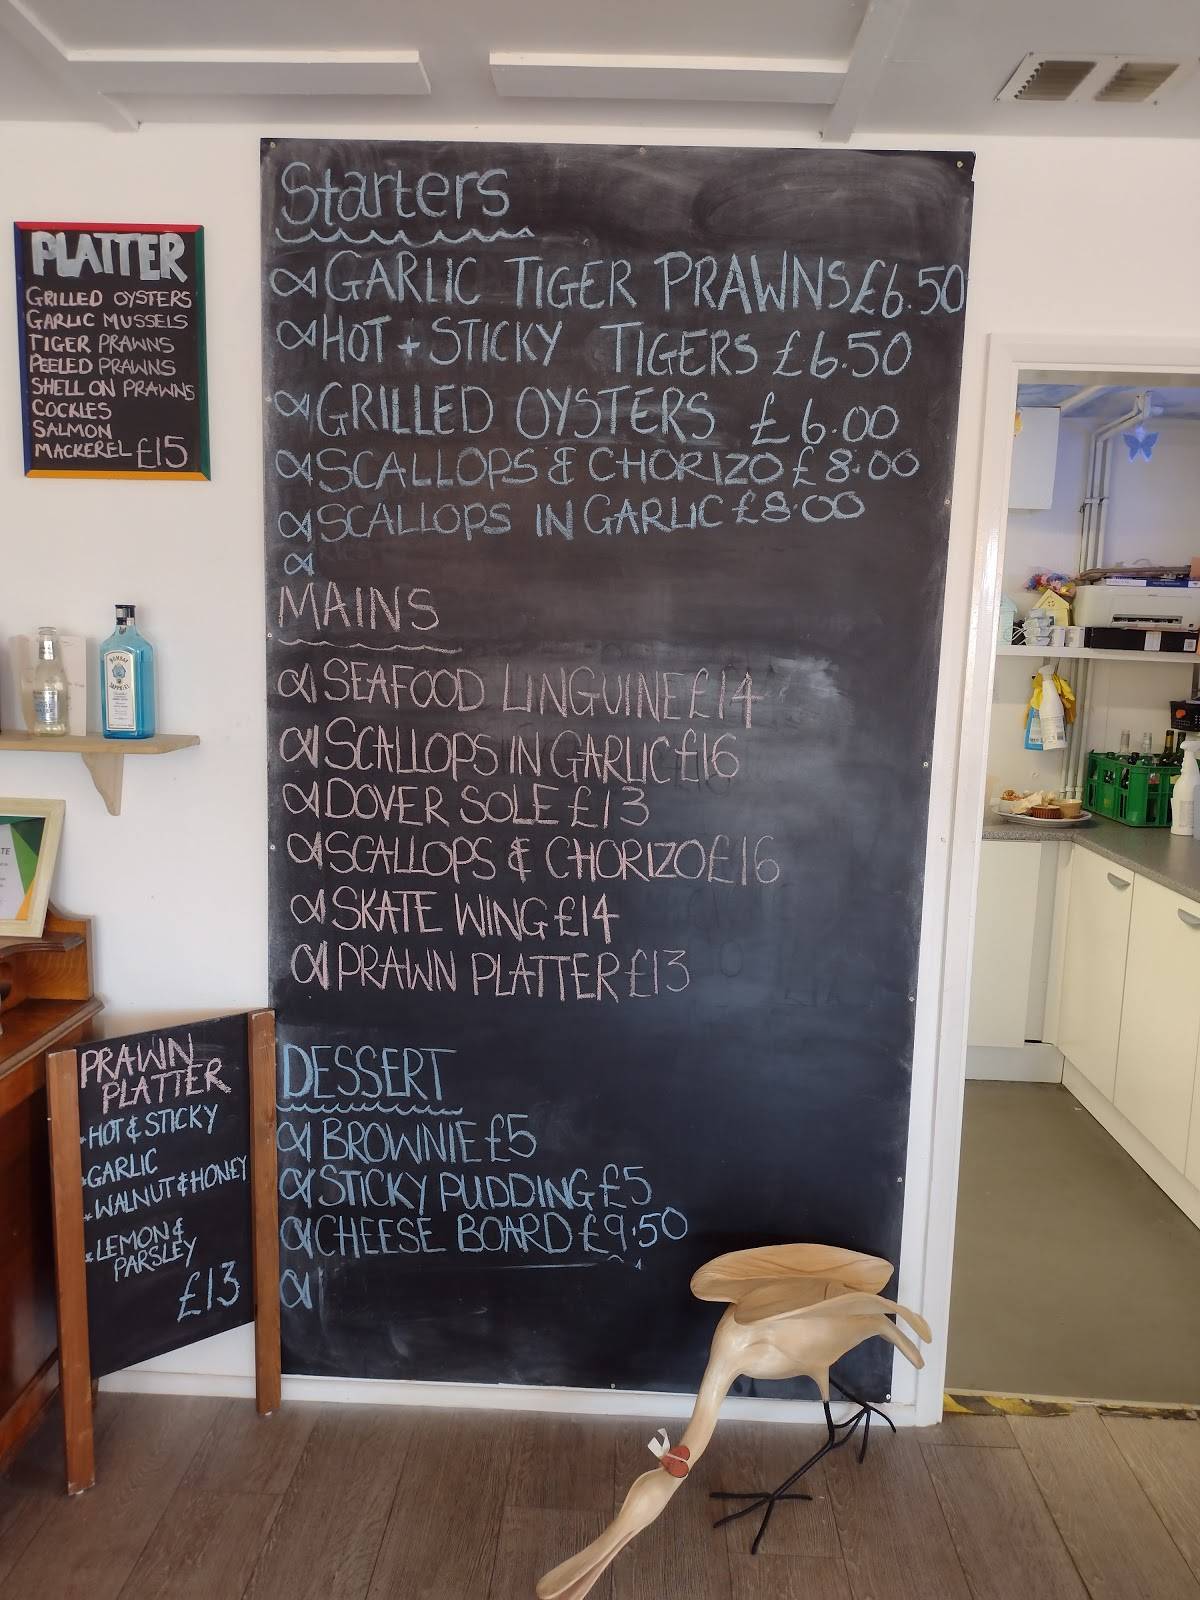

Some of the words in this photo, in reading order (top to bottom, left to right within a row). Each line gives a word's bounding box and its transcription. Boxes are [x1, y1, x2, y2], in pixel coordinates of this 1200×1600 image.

[282, 161, 510, 224] Starters
[31, 231, 188, 283] PLATTER
[325, 250, 482, 304] GARLIC
[504, 256, 637, 309] TIGER
[654, 251, 851, 313] PRAWNS
[25, 286, 103, 307] GRILLED
[113, 289, 192, 309] OYSTERS
[26, 309, 95, 330] GARLIC
[103, 313, 189, 330] MUSSELS
[28, 333, 92, 353] TIGER
[98, 334, 175, 354] PRAWNS
[29, 354, 93, 375] PEELED
[98, 357, 177, 377] PRAWNS
[323, 314, 392, 363] HOT
[397, 335, 421, 357] +
[430, 317, 562, 366] STICKY
[600, 322, 758, 377] TIGERS
[773, 330, 912, 379] £6.50
[31, 377, 85, 396] SHELL
[88, 378, 116, 398] ON
[123, 379, 195, 401] PRAWNS
[31, 399, 112, 420] COCKLES
[316, 382, 494, 437] GRILLED
[516, 385, 715, 442] OYSTERS
[32, 420, 113, 439] SALMON
[35, 439, 132, 459] MACKEREL
[136, 435, 188, 469] £15
[316, 447, 538, 493] SCALLOPS
[547, 447, 576, 485] &
[589, 447, 784, 486] CHORIZO
[316, 502, 511, 542] SCALLOPS
[536, 500, 574, 541] IN
[584, 494, 724, 535] GARLIC
[278, 581, 440, 632] MAINS
[323, 658, 485, 711] SEAFOOD
[503, 663, 685, 722] LINGUINE
[689, 667, 765, 729] £14
[324, 717, 499, 782] SCALLOPS
[509, 732, 542, 776] IN
[550, 730, 671, 784] GARLIC
[675, 728, 740, 783] £16
[325, 778, 449, 827] DOVER
[460, 784, 559, 825] SOLE
[568, 785, 649, 829] £13
[325, 831, 496, 884] SCALLOPS
[508, 836, 531, 884] &
[546, 836, 706, 882] CHORIZO
[707, 834, 780, 886] £16
[332, 886, 443, 934] SKATE
[455, 893, 548, 941] WING
[554, 893, 620, 944] £14
[338, 942, 457, 991] PRAWN
[471, 952, 619, 1003] PLATTER
[625, 949, 689, 997] £13
[80, 1032, 194, 1089] PRAWN
[101, 1057, 232, 1115] PLATTER
[283, 1043, 457, 1100] DESSERT
[88, 1117, 124, 1150] HOT
[126, 1115, 142, 1144] &
[144, 1103, 219, 1137] STICKY
[322, 1117, 482, 1164] BROWNIE
[485, 1113, 537, 1162] £5
[87, 1148, 158, 1188] GARLIC
[94, 1176, 176, 1220] WALNUT
[176, 1172, 190, 1198] &
[190, 1155, 248, 1194] HONEY
[318, 1164, 427, 1216] STICKY
[440, 1168, 596, 1212] PUDDING
[599, 1163, 652, 1208] £5
[96, 1220, 169, 1261] LEMON
[172, 1217, 185, 1244] &
[114, 1236, 198, 1283] PARSLEY
[314, 1214, 447, 1258] CHEESE
[457, 1212, 573, 1254] BOARD
[177, 1260, 241, 1323] £13
